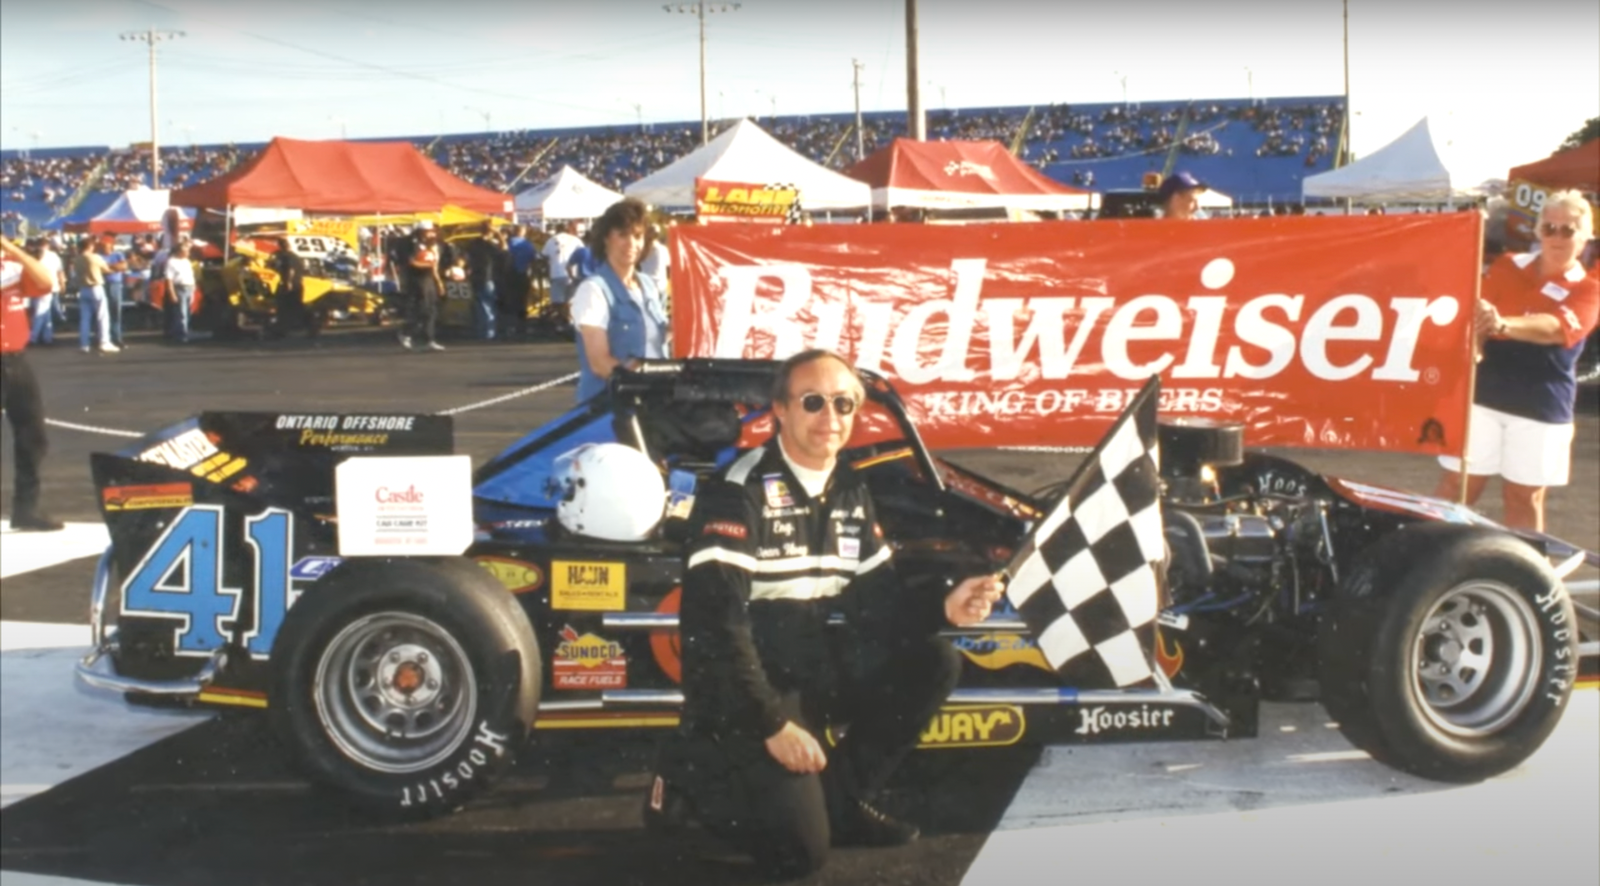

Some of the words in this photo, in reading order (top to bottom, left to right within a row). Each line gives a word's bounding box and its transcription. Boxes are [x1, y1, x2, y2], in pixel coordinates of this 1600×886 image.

[294, 238, 326, 252] 29
[448, 282, 471, 299] 26
[714, 257, 1459, 384] Budweiser
[926, 390, 1026, 416] KING
[1034, 389, 1089, 414] OF
[276, 414, 339, 430] ONTARIO
[342, 415, 416, 431] OFFSHORE
[300, 428, 389, 447] Performance
[375, 484, 424, 503] Castle
[120, 504, 295, 660] 41
[561, 643, 617, 659] SUNOCO
[560, 675, 588, 685] RACE
[589, 675, 622, 686] FUELS
[1074, 704, 1174, 734] Hoosier
